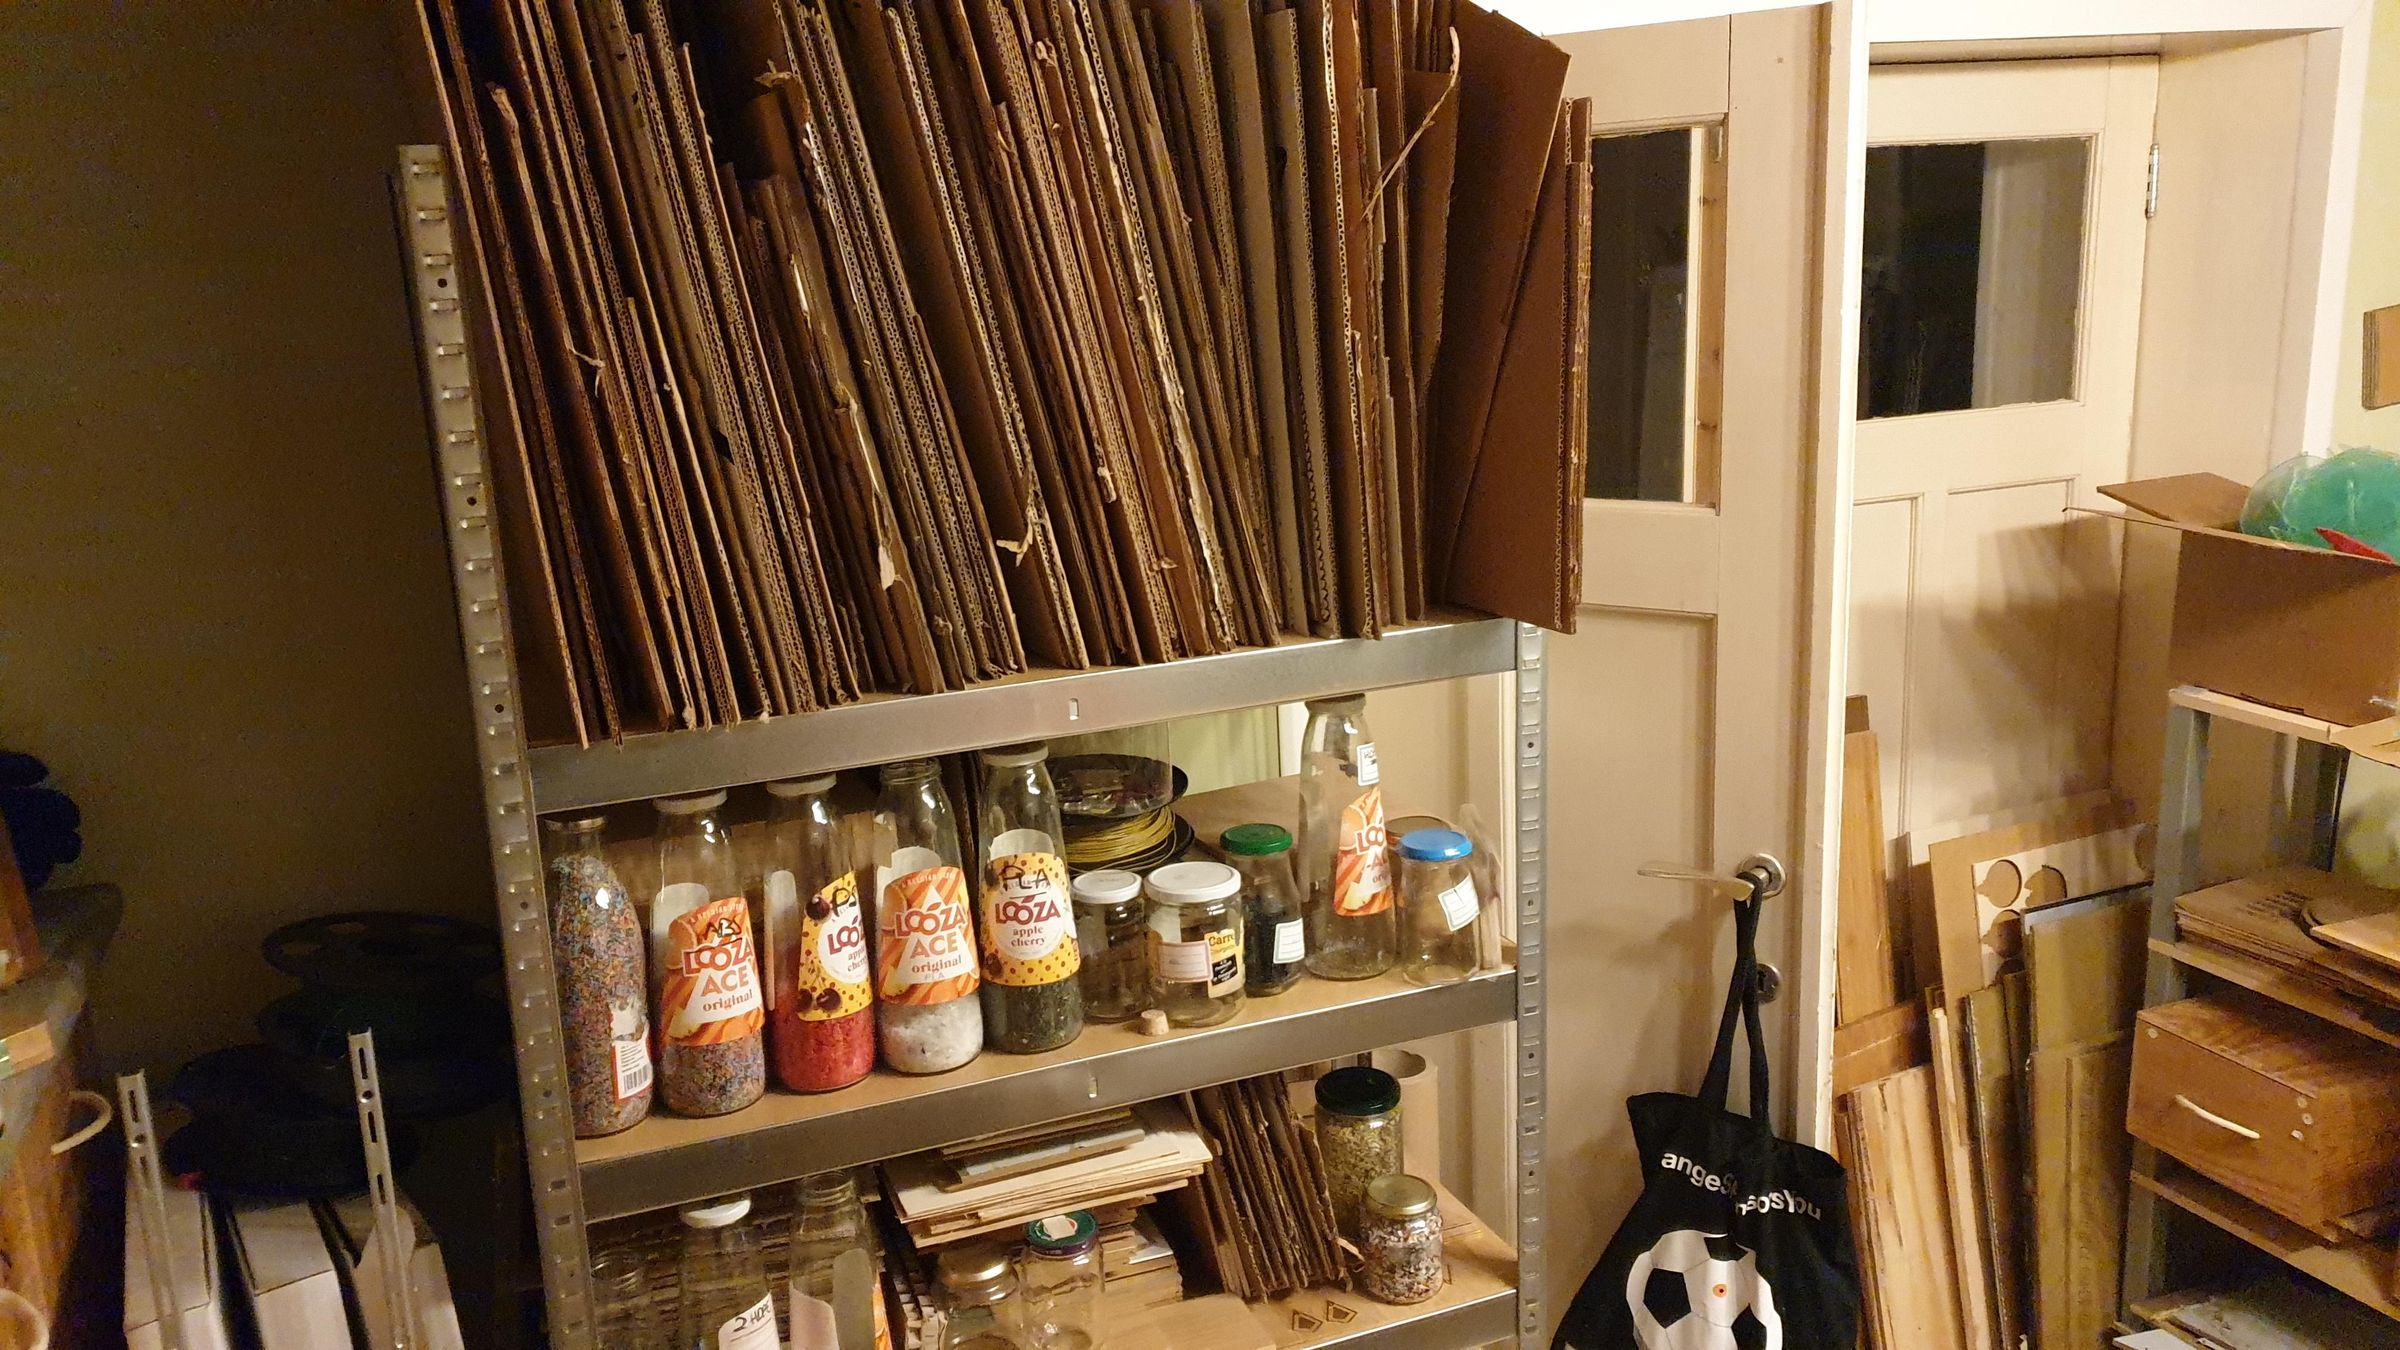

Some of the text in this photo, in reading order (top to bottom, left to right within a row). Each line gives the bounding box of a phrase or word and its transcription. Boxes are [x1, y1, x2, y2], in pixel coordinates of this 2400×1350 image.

[1356, 825, 1385, 853] LOO
[999, 865, 1051, 892] PLA
[895, 904, 965, 937] LOOZA
[995, 899, 1061, 925] LOOZA
[827, 925, 865, 955] LOO
[910, 932, 958, 959] ACE
[1010, 937, 1045, 948] cherry
[1013, 926, 1044, 938] apple
[683, 939, 754, 975] LOOZA
[911, 954, 962, 973] original
[701, 965, 749, 997] ACE
[702, 988, 753, 1012] original
[733, 1316, 748, 1333] 2
